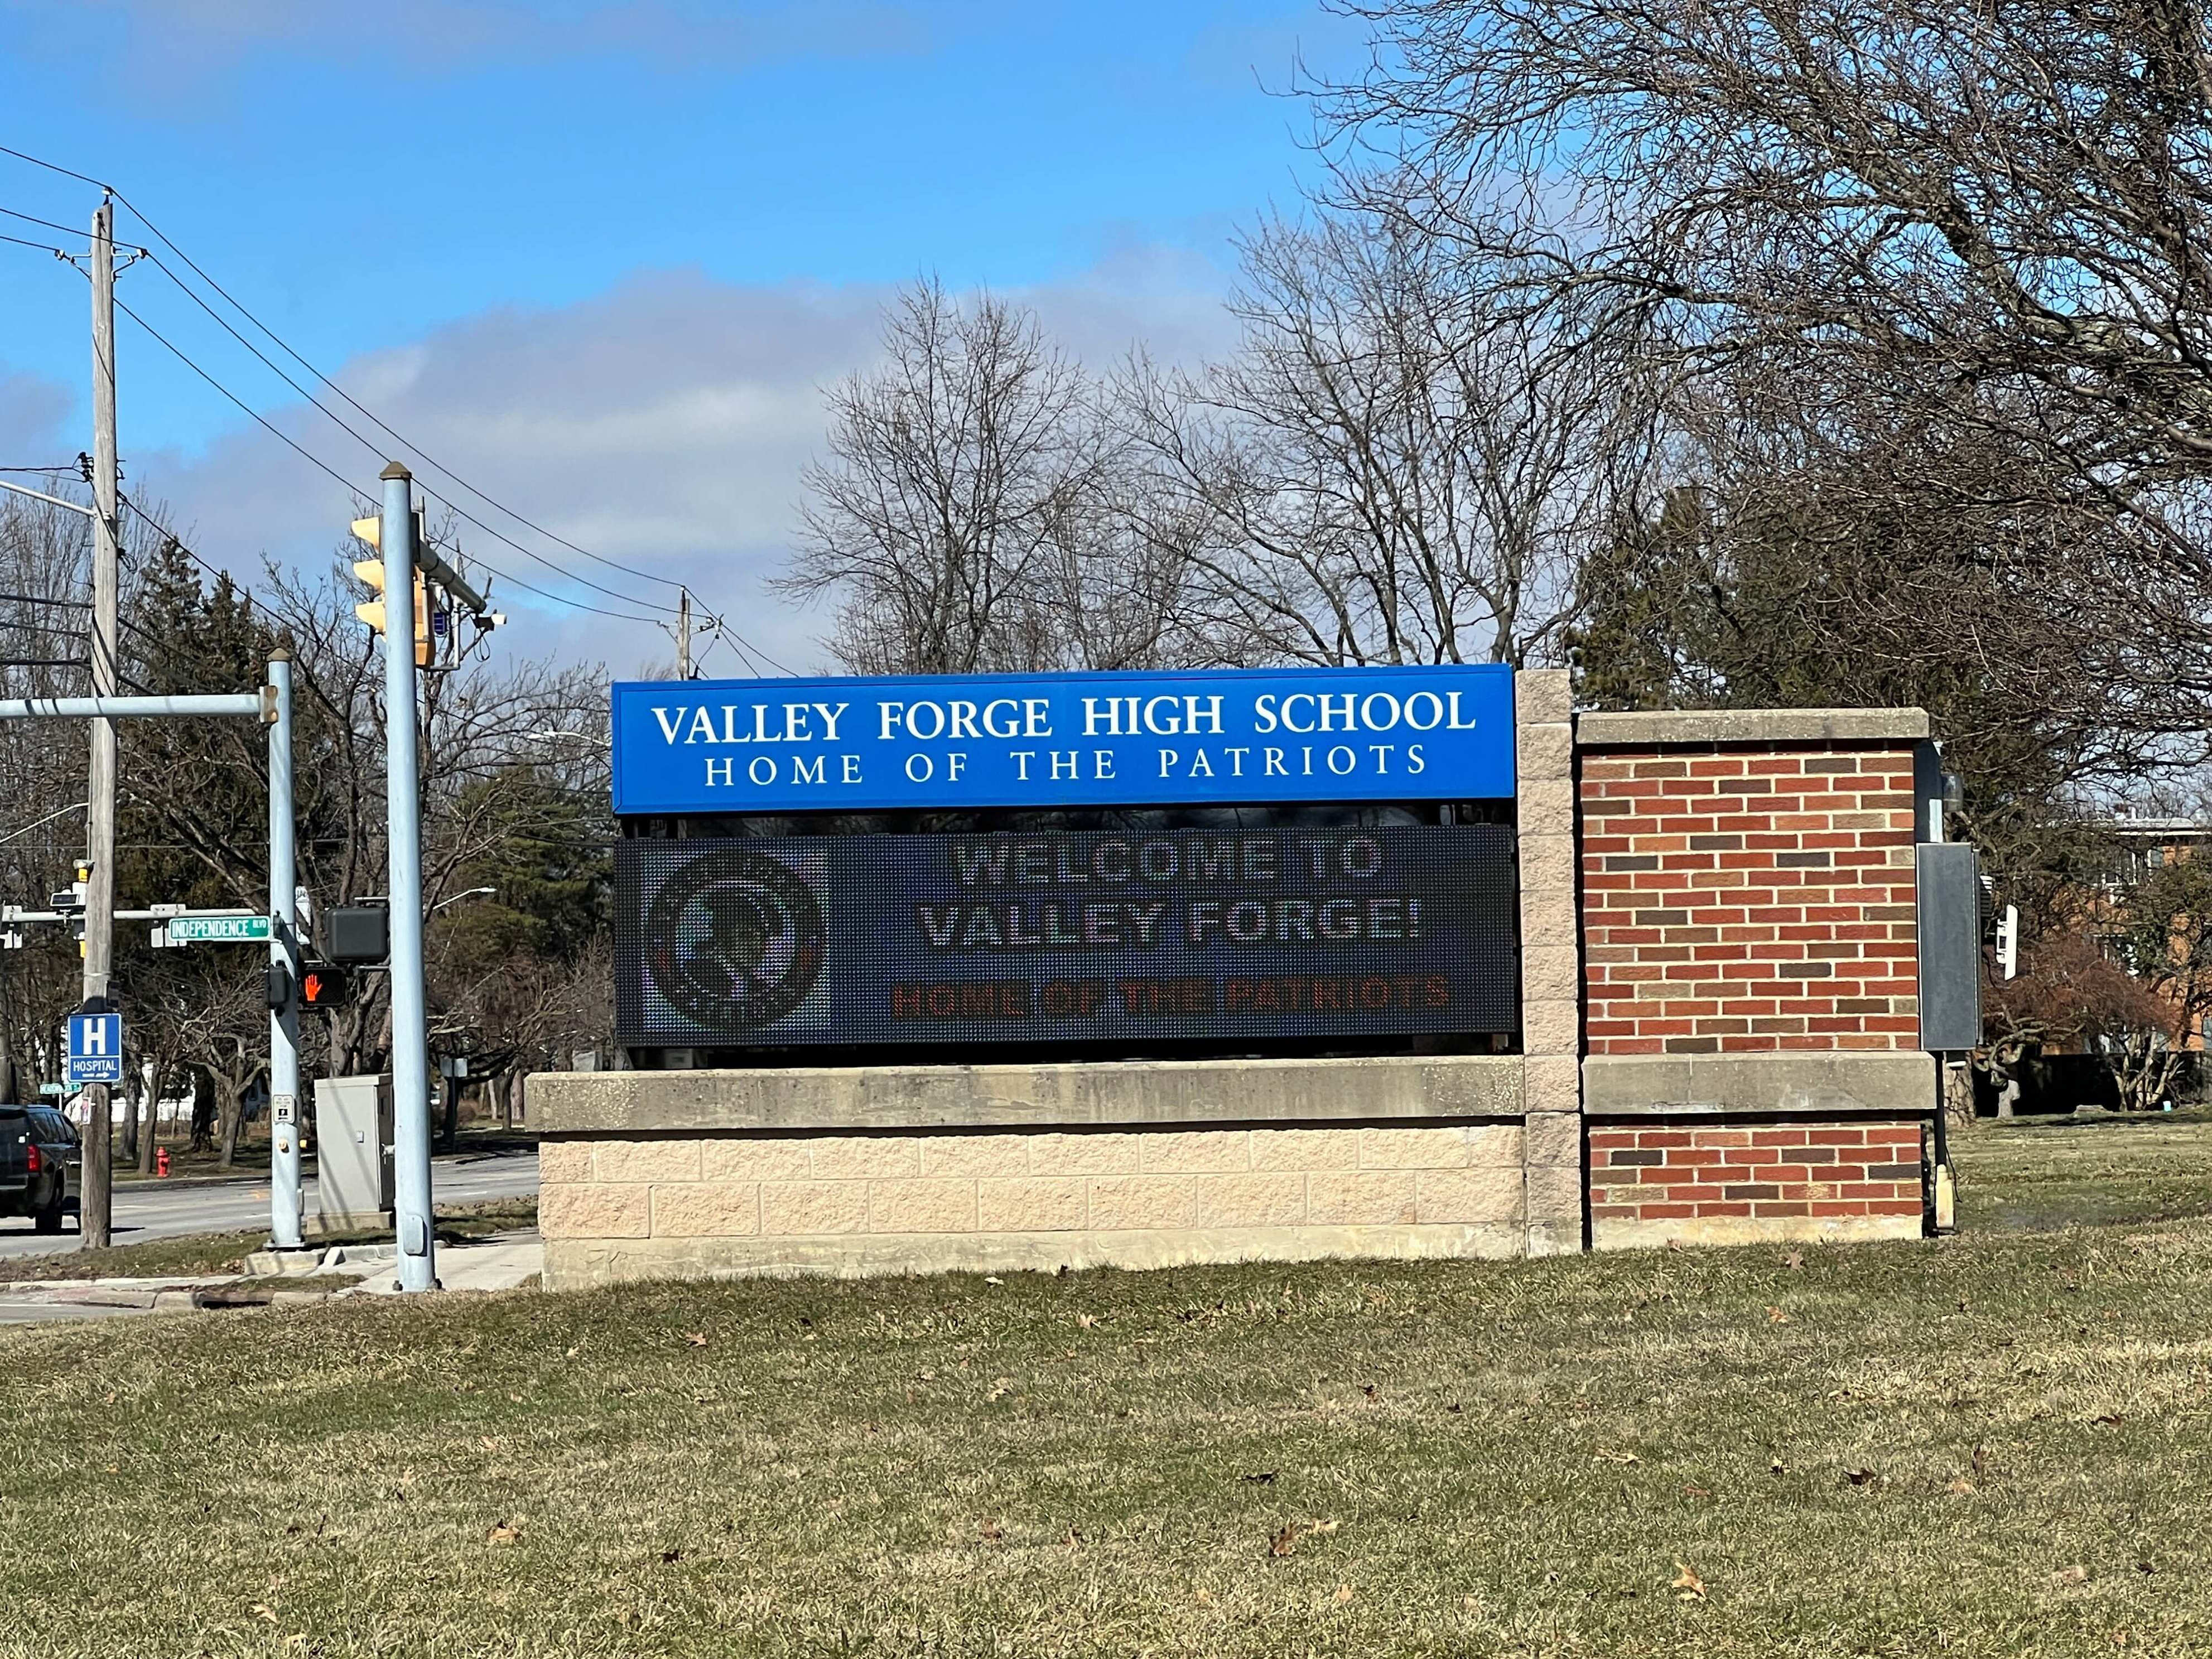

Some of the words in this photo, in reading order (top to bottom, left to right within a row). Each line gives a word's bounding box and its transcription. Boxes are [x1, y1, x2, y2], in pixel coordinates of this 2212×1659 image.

[652, 703, 849, 744] VALLEY
[878, 700, 1052, 739] FORGE
[1082, 696, 1224, 735] HIGH
[1256, 692, 1475, 732] SCHOOL
[705, 756, 861, 785] HOME
[906, 754, 966, 782] OF
[1010, 751, 1115, 779] THE
[1159, 745, 1424, 777] PATRIOTS
[953, 838, 1275, 886] WELCOME
[1298, 835, 1382, 878] TO
[172, 920, 249, 938] INDEPENDENCE
[252, 919, 267, 929] BLVD
[919, 902, 1165, 946] VALLEY
[1188, 898, 1422, 942] FORGE!
[894, 983, 1025, 1017] HOME
[1044, 981, 1103, 1014] OF
[1119, 980, 1209, 1012] THE
[1228, 975, 1449, 1011] PATRIOTS
[83, 1017, 105, 1055] H
[73, 1060, 117, 1072] HOSPITAL
